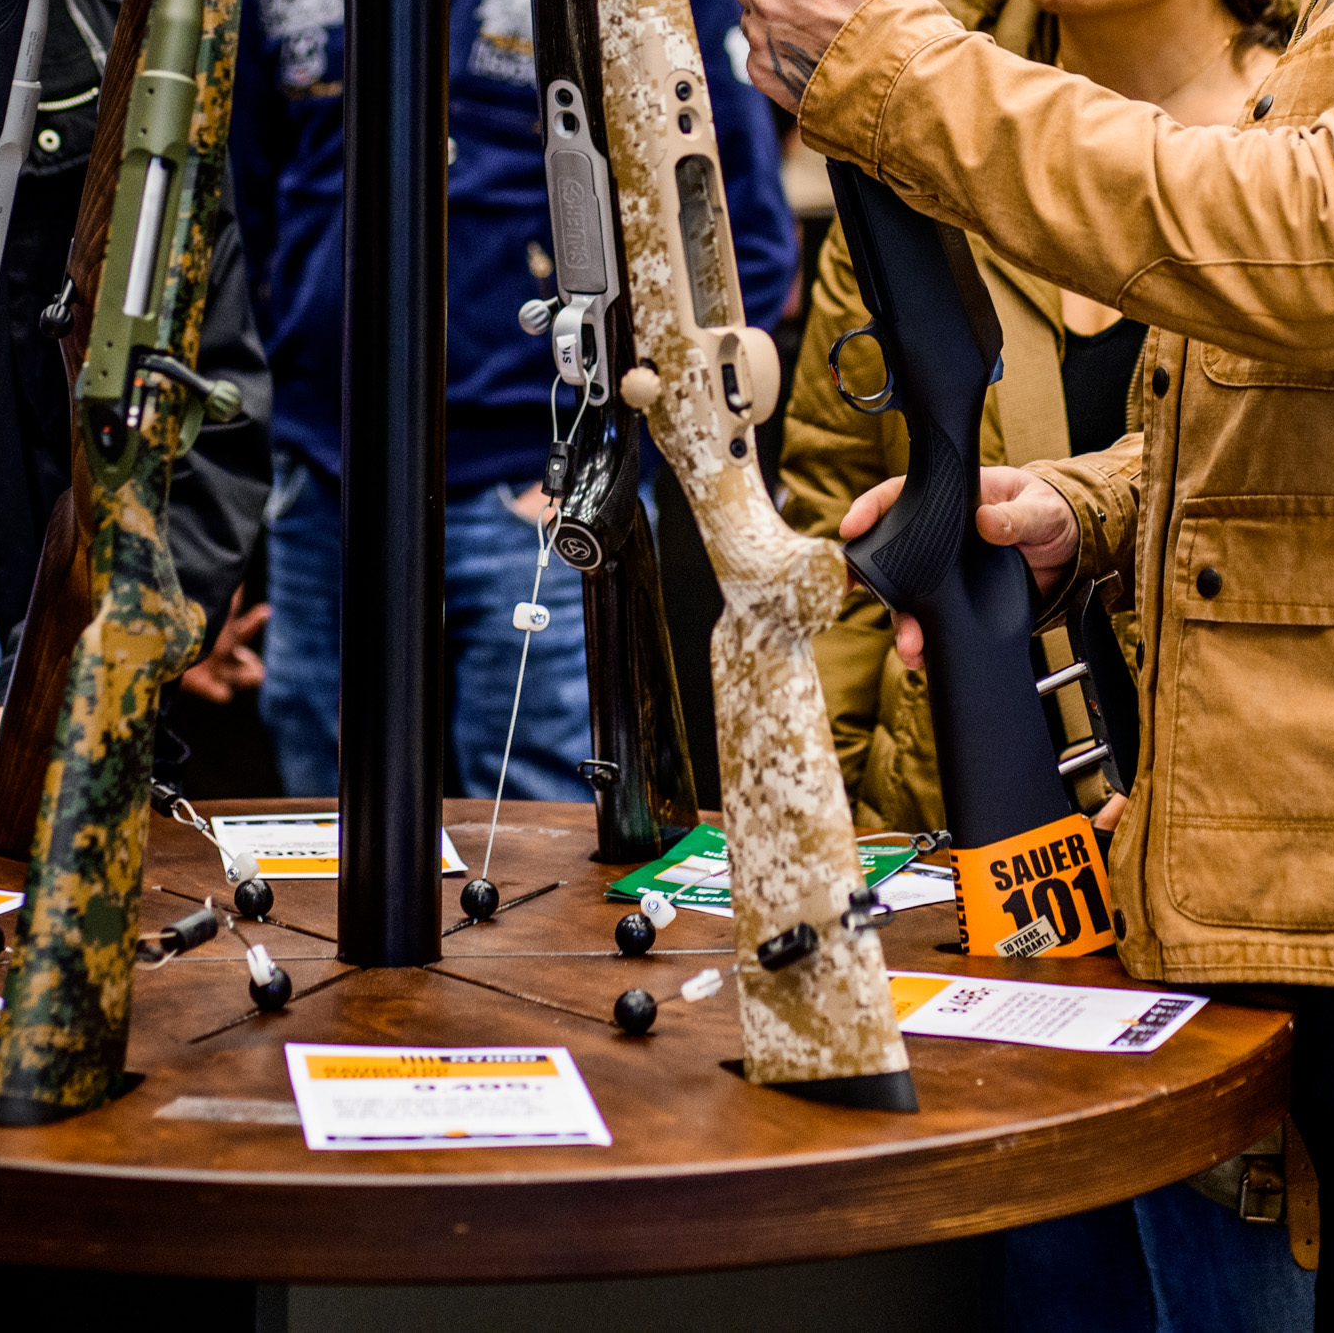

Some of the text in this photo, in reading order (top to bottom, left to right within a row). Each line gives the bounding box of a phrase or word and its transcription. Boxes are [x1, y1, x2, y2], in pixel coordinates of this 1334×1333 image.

[566, 205, 588, 265] SAUER
[989, 833, 1091, 892] SAUER
[1001, 863, 1112, 947] 101
[1003, 928, 1041, 955] 10 YEARS
[1010, 932, 1053, 958] ARRANTY
